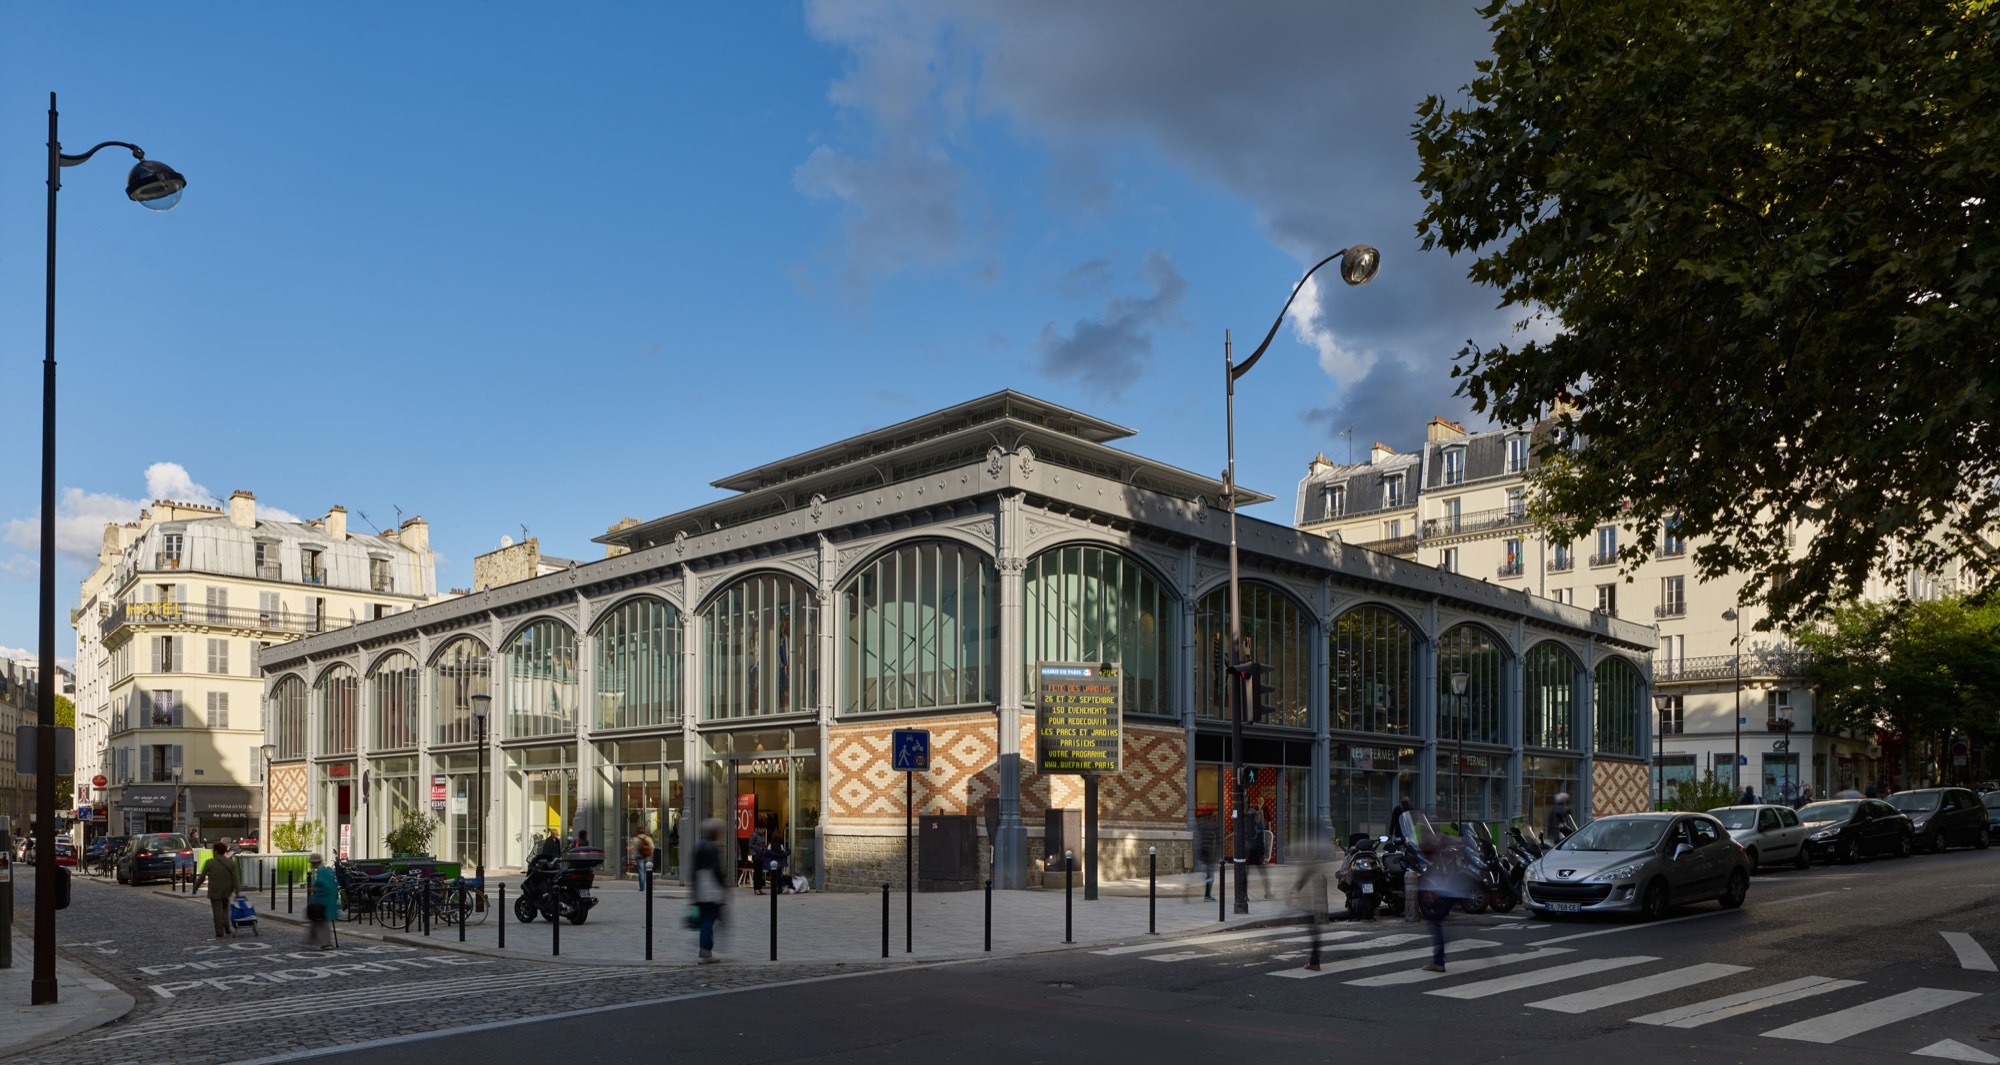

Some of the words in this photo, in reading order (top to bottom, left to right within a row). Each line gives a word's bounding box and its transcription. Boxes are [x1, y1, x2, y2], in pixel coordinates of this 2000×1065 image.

[126, 603, 184, 616] HOTEL
[1049, 685, 1065, 693] FETE
[1068, 685, 1080, 693] DES
[1084, 685, 1111, 693] JARDINS
[1045, 695, 1053, 703] 26
[1080, 696, 1115, 704] SEPTEMBRE
[1053, 706, 1065, 714] 150
[1049, 717, 1065, 725] POUR
[1041, 728, 1053, 736] LES
[1056, 728, 1077, 736] PARCS
[1091, 729, 1119, 737] JARDINS
[1049, 750, 1069, 758] VOTRE
[1370, 748, 1395, 760] FERMES
[1467, 755, 1488, 767] FERMES
